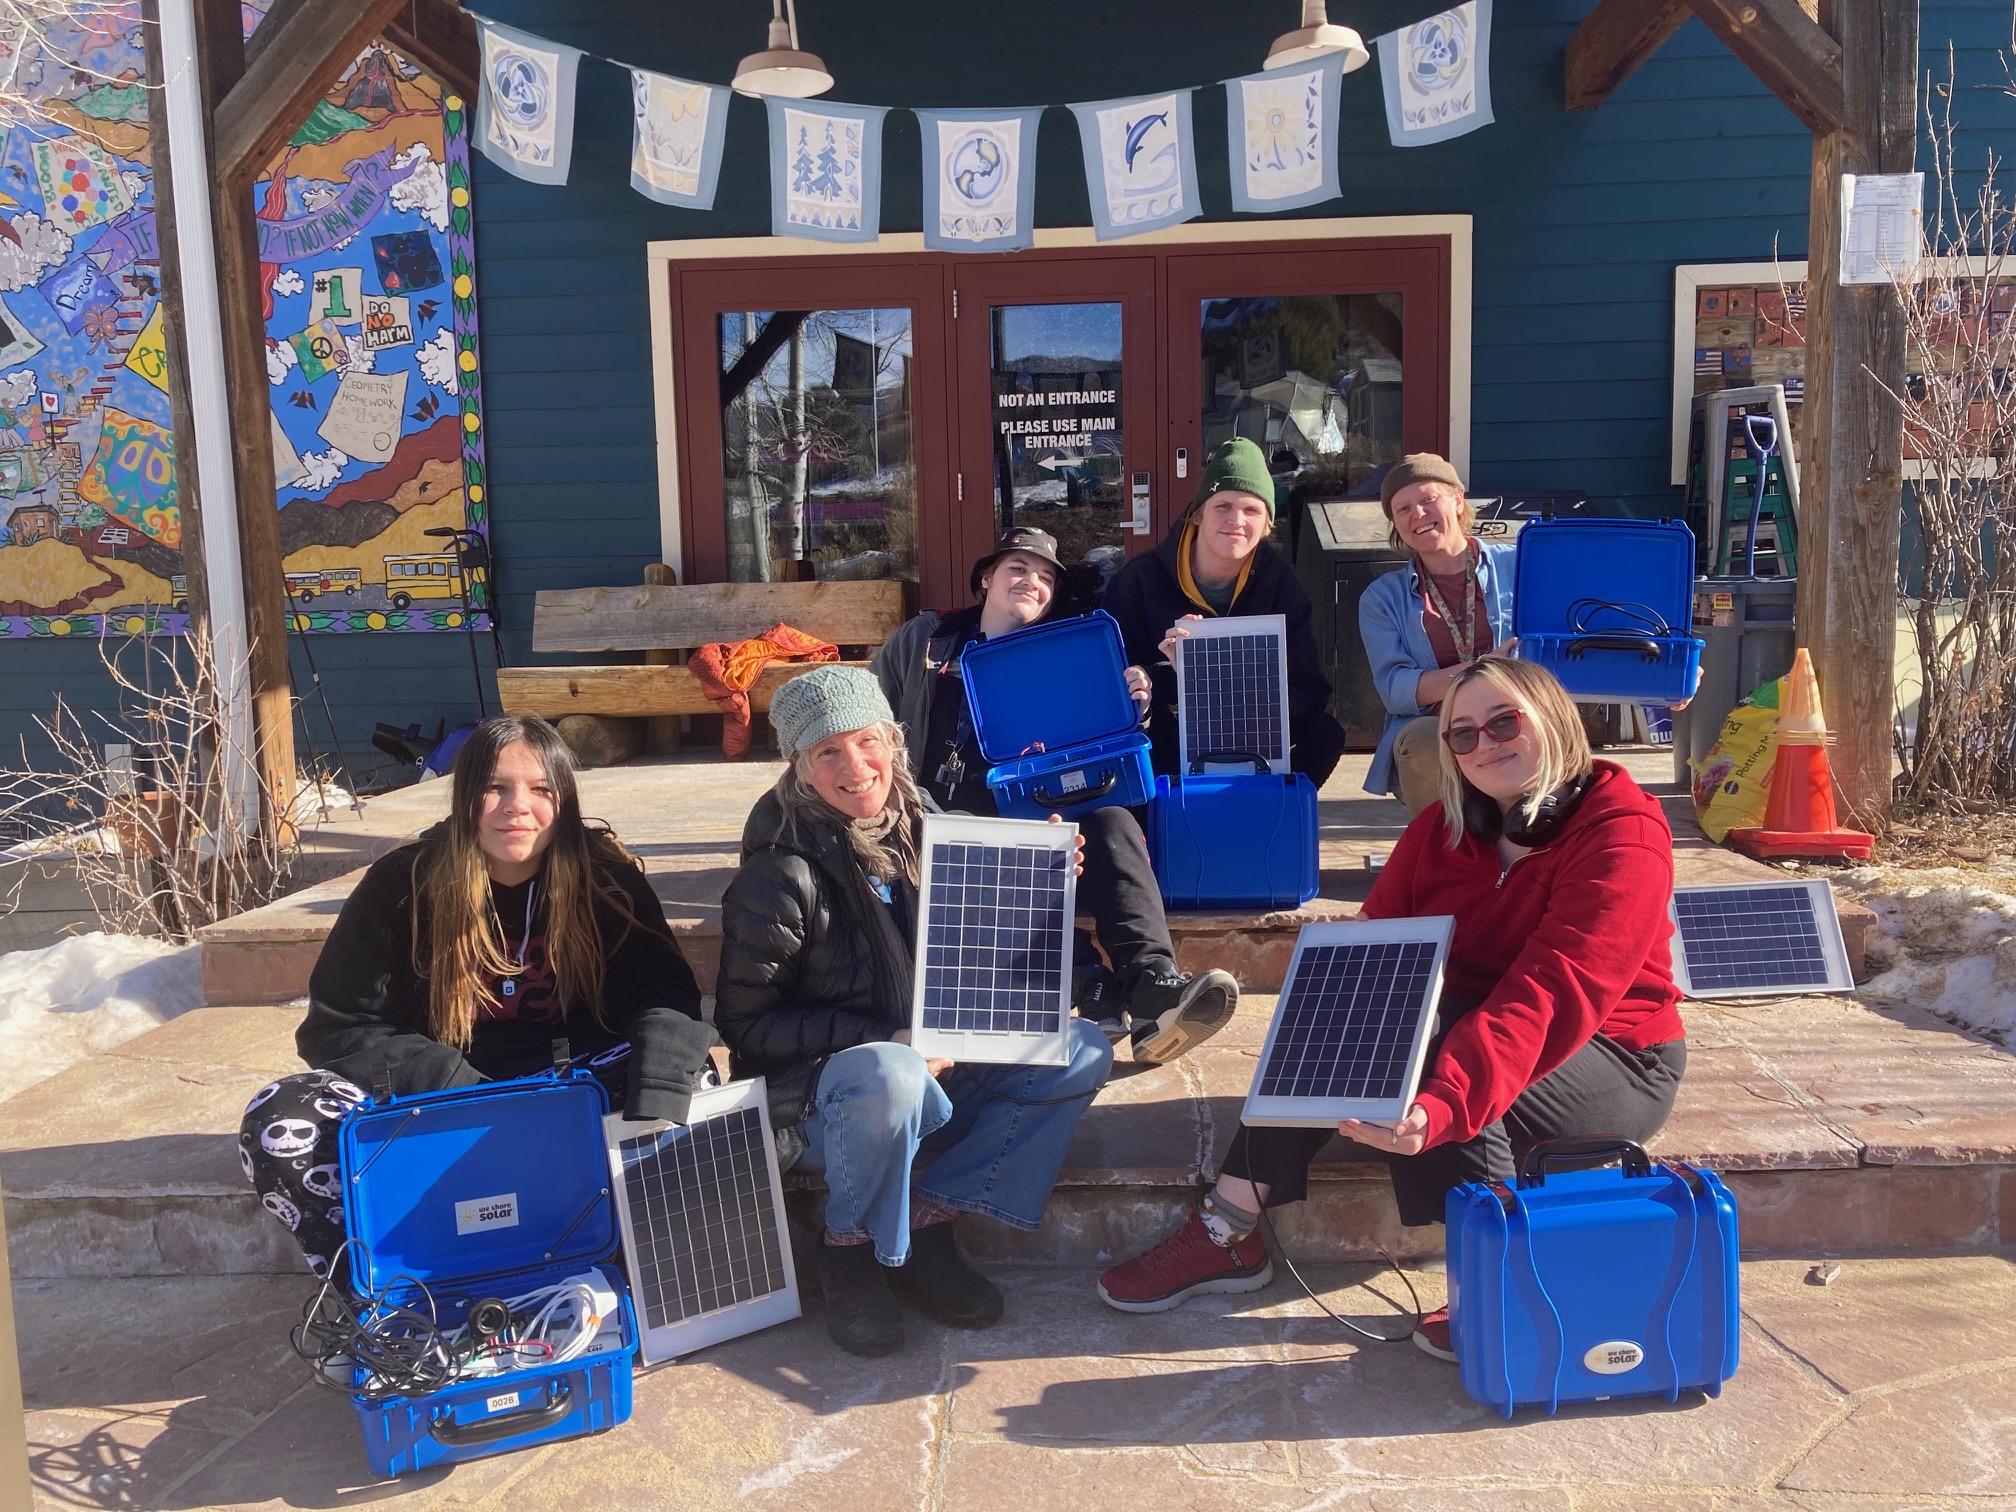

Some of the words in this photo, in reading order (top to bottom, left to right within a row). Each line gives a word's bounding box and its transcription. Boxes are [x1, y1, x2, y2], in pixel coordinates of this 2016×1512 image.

[130, 221, 152, 254] IF
[284, 229, 299, 257] IF
[297, 218, 324, 253] NOT
[55, 265, 98, 311] Dream
[315, 275, 351, 318] #1
[369, 301, 390, 314] DO
[366, 313, 395, 330] NO
[341, 390, 398, 410] HOMEWORK
[999, 393, 1024, 408] NOT
[1025, 393, 1045, 406] AN
[1048, 390, 1116, 405] ENTRANCE
[1001, 420, 1049, 435] PLEASE
[1052, 419, 1078, 433] USE
[1081, 417, 1116, 431] MAIN
[1025, 434, 1092, 449] ENTRANCE
[1735, 743, 1768, 778] Potting
[479, 1208, 513, 1222] solar
[490, 1202, 512, 1211] share
[1608, 1355, 1637, 1364] solar
[492, 1396, 514, 1408] 0028
